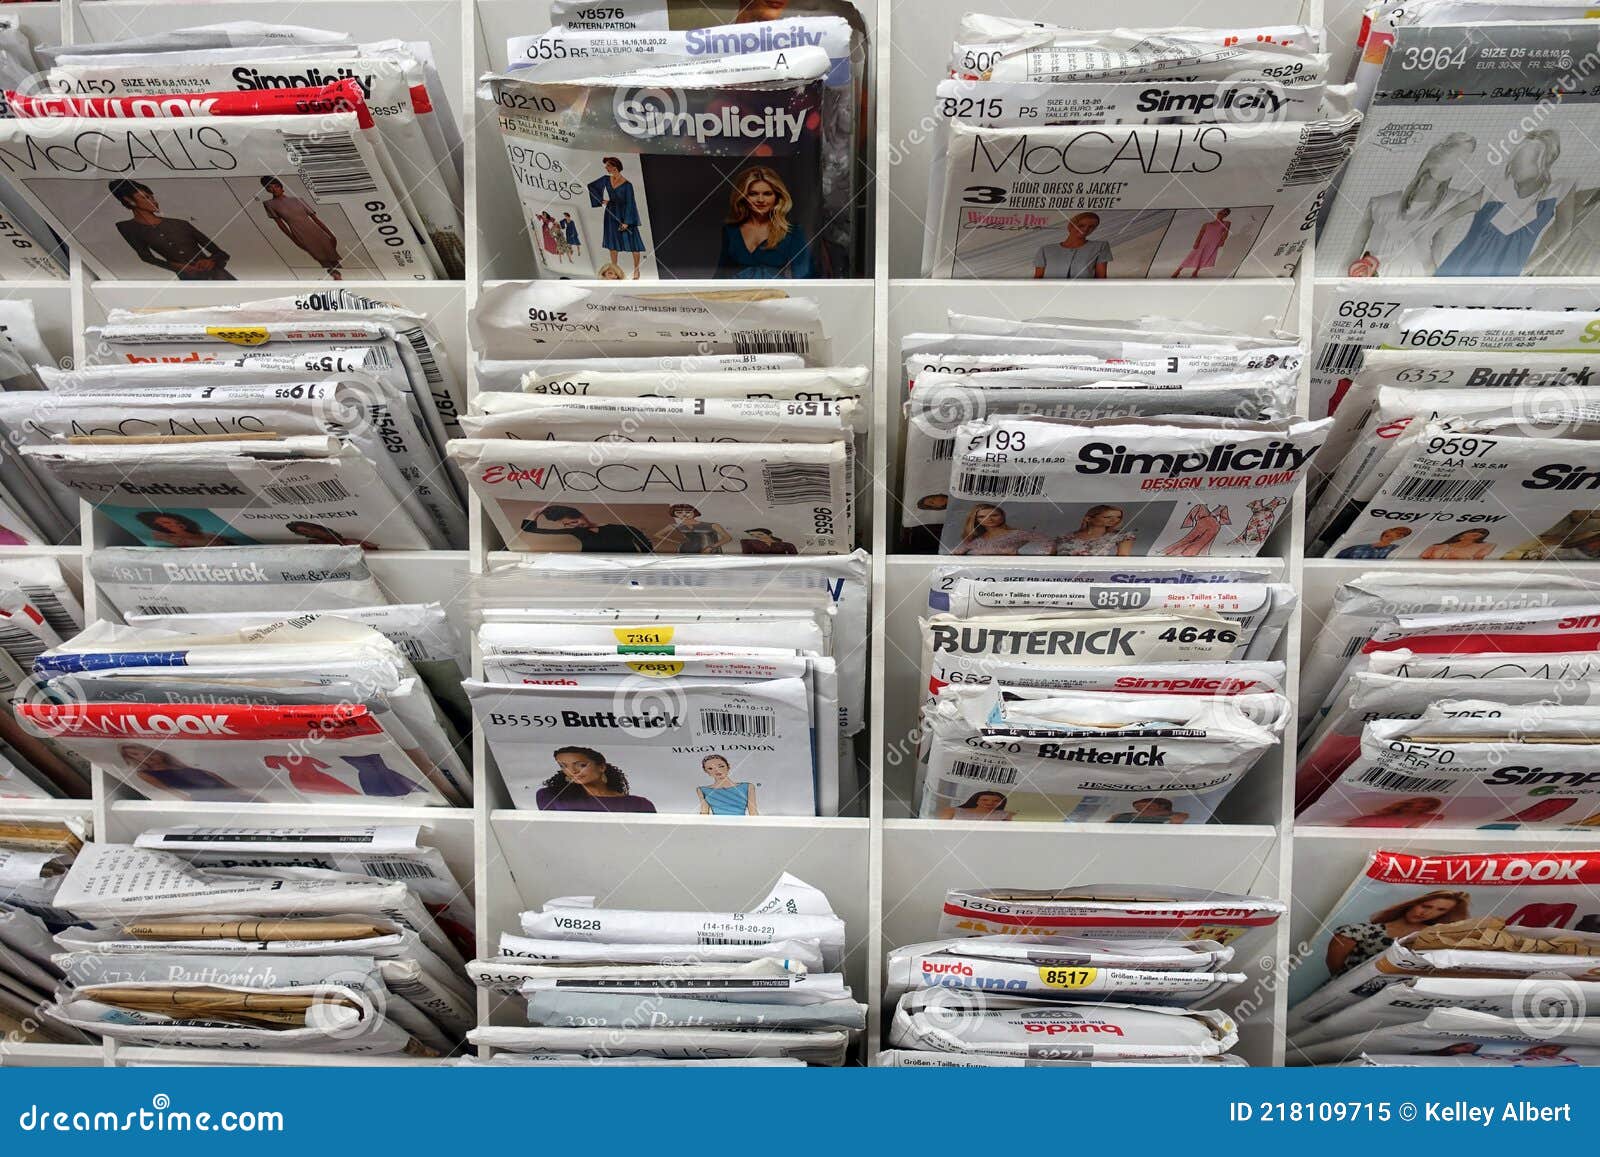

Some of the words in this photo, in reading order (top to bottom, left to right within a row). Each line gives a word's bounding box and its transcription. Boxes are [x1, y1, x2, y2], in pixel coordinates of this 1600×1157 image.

[567, 22, 637, 30] PATTERN/PATRON
[684, 25, 822, 56] Simplicity
[774, 53, 790, 71] A
[1401, 46, 1467, 71] 3964
[1480, 48, 1508, 59] SIZE
[1509, 47, 1526, 59] D5
[232, 66, 377, 99] Simplicity
[942, 98, 1003, 119] 8215
[1019, 107, 1039, 119] P5
[1136, 88, 1289, 114] Simplicity
[616, 99, 807, 144] Simplicity
[506, 143, 563, 174] 1970s
[971, 127, 1228, 175] McCALL'S
[511, 164, 585, 201] Vintage
[1012, 182, 1040, 194] HOUR
[1042, 183, 1075, 194] DRESS
[962, 185, 1008, 204] 3
[1009, 197, 1047, 208] HEURES
[528, 307, 569, 323] 2106
[1338, 300, 1401, 319] 6857
[1353, 318, 1364, 328] A
[1399, 328, 1459, 347] 1665
[1458, 337, 1478, 347] R5
[1166, 356, 1179, 374] E
[1395, 367, 1455, 385] 6352
[1465, 365, 1596, 388] Butterick
[693, 398, 706, 415] E
[1426, 436, 1498, 459] 9597
[1075, 441, 1322, 479] Simplicity
[481, 464, 545, 485] Easy
[508, 462, 749, 493] McCALL'S
[1140, 477, 1204, 490] DESIGN
[1207, 475, 1251, 488] YOUR
[1254, 471, 1294, 487] OWN
[242, 511, 290, 522] DAVID
[292, 508, 360, 521] WARREN
[1369, 507, 1431, 524] easy
[1432, 510, 1452, 522] to
[1456, 512, 1508, 524] sew
[162, 561, 270, 582] Butterick
[1096, 591, 1142, 607] 8510
[627, 634, 661, 643] 7361
[930, 623, 1139, 656] BUTTERICK
[1157, 626, 1239, 644] 4646
[633, 662, 676, 673] 7681
[1112, 676, 1263, 692] Simplicity
[489, 712, 558, 729] B5559
[560, 711, 682, 729] Butterick
[671, 743, 719, 754] MAGGY
[720, 744, 777, 753] LONDON
[1036, 742, 1168, 767] Butterick
[958, 898, 1011, 915] 1356
[553, 916, 602, 932] V8828
[921, 960, 974, 977] burda
[1045, 970, 1089, 985] 8517
[1023, 1023, 1125, 1037] burda
